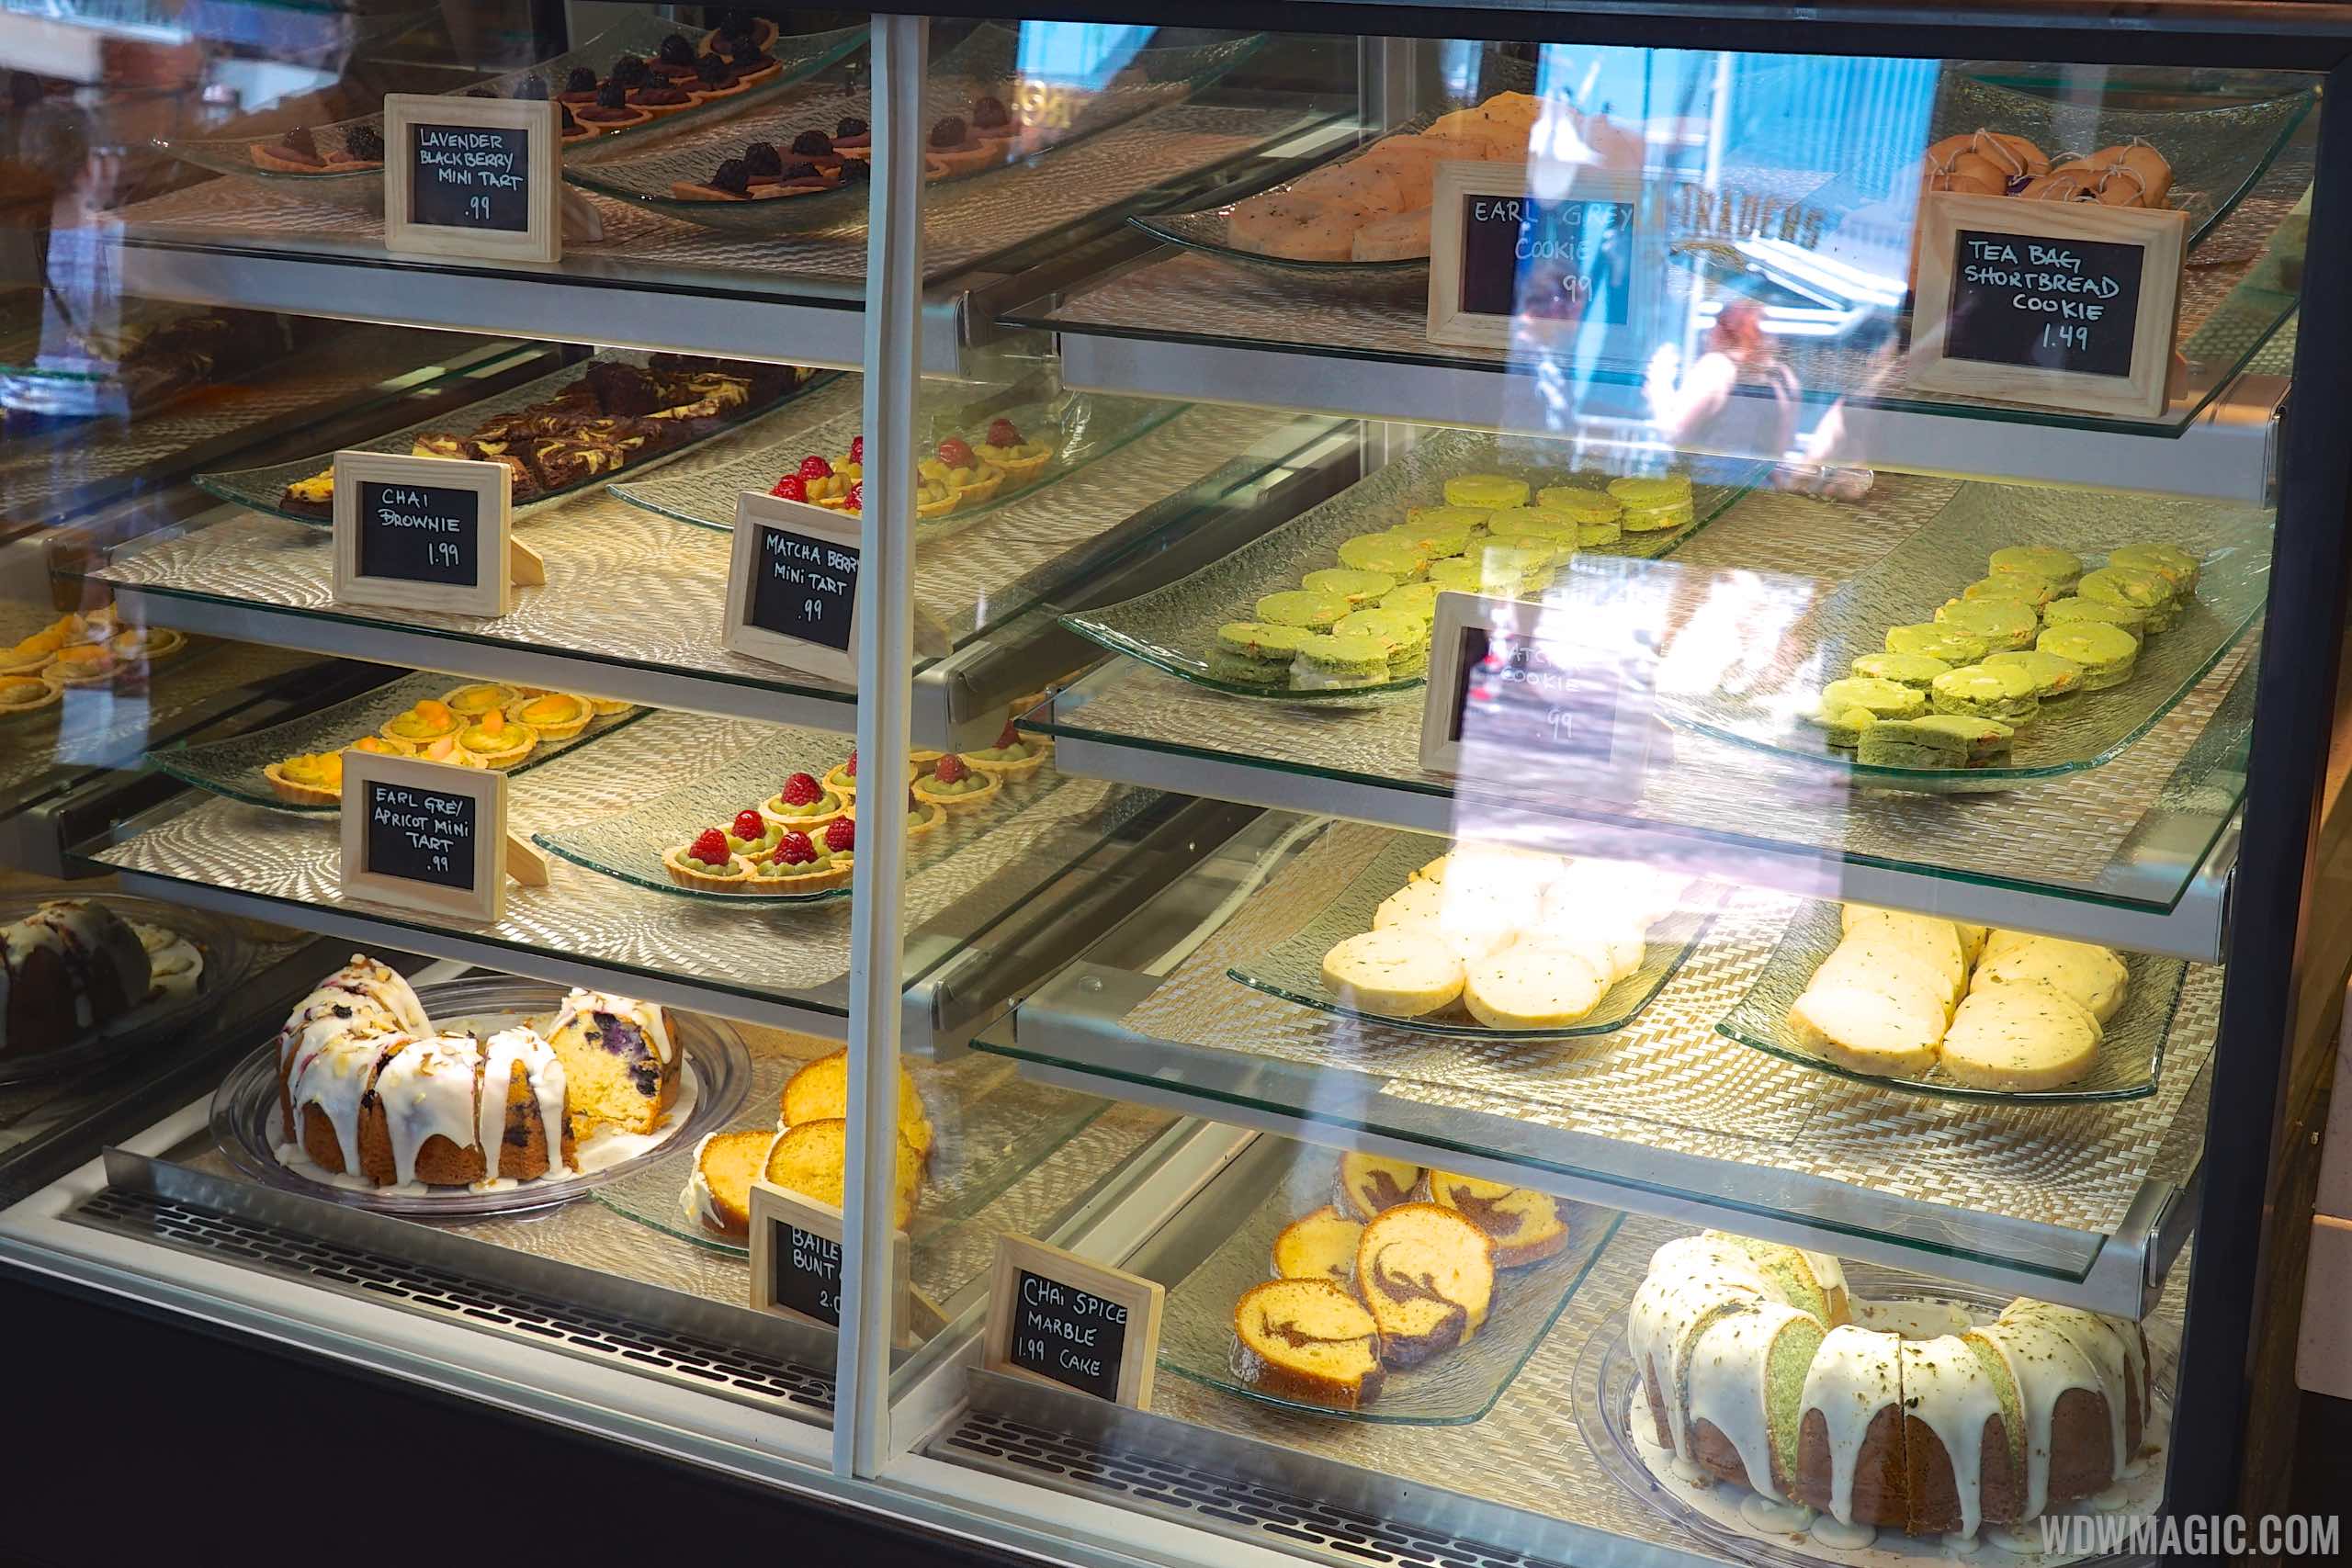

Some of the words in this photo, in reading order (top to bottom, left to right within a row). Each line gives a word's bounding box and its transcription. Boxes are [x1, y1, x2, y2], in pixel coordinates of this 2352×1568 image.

[420, 129, 503, 150] LAVENDER
[438, 168, 472, 185] MINI
[477, 171, 524, 191] TART
[465, 197, 491, 220] .99
[1475, 201, 1538, 222] EARL
[1563, 204, 1634, 231] GREY
[1968, 241, 2018, 264] TEA
[2029, 244, 2081, 274] BAG
[1553, 274, 1593, 303] .99
[1964, 265, 2120, 299] SHORTBREAD
[2013, 293, 2104, 321] COOKIE
[2042, 322, 2088, 351] 1.49
[382, 488, 428, 508] CHAI
[378, 508, 461, 532] BROWNIE
[428, 542, 459, 567] 1.99
[766, 534, 821, 566] MATCHA
[808, 573, 847, 596] TART
[797, 599, 822, 622] .99
[375, 787, 418, 807] EARL
[374, 807, 429, 830] APRICOT
[405, 831, 454, 852] TART
[426, 856, 449, 872] .99
[793, 1249, 835, 1280] BUNT
[1073, 1292, 1126, 1325] SPICE
[1028, 1310, 1097, 1347] MARBLE
[1018, 1337, 1045, 1361] 1.99
[1059, 1348, 1102, 1377] CAKE
